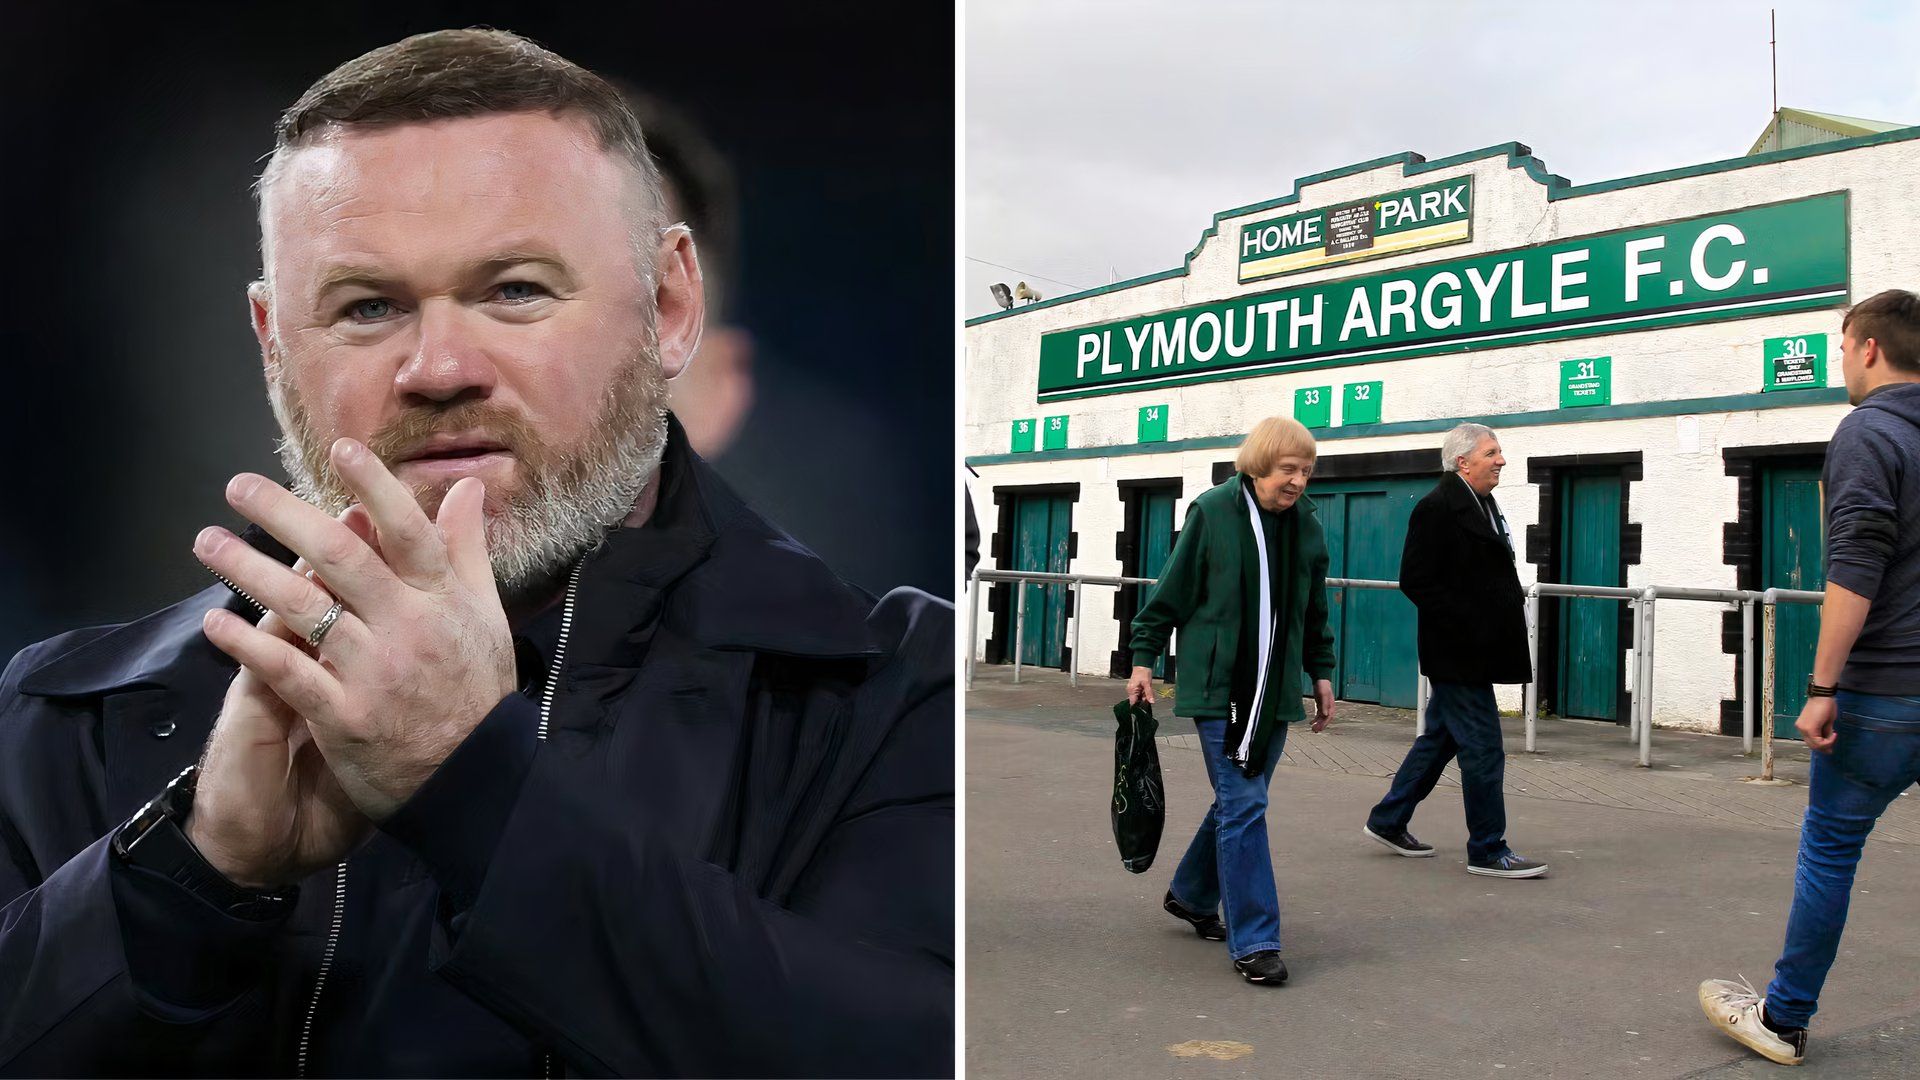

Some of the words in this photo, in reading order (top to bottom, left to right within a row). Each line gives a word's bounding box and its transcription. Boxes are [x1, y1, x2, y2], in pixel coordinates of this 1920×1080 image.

[1242, 215, 1322, 257] HOME
[1379, 184, 1467, 229] PARK
[1076, 293, 1324, 379] PLYMOUTH
[1339, 248, 1590, 341] ARGYLE
[1625, 224, 1769, 302] F.C.
[1782, 338, 1807, 357] 30
[1577, 360, 1595, 377] 31
[1354, 384, 1370, 401] 32
[1568, 382, 1600, 390] GRANDSTAND
[1304, 389, 1320, 405] 33
[1146, 408, 1159, 422] 34
[1018, 421, 1029, 434] 36
[1051, 418, 1062, 431] 35
